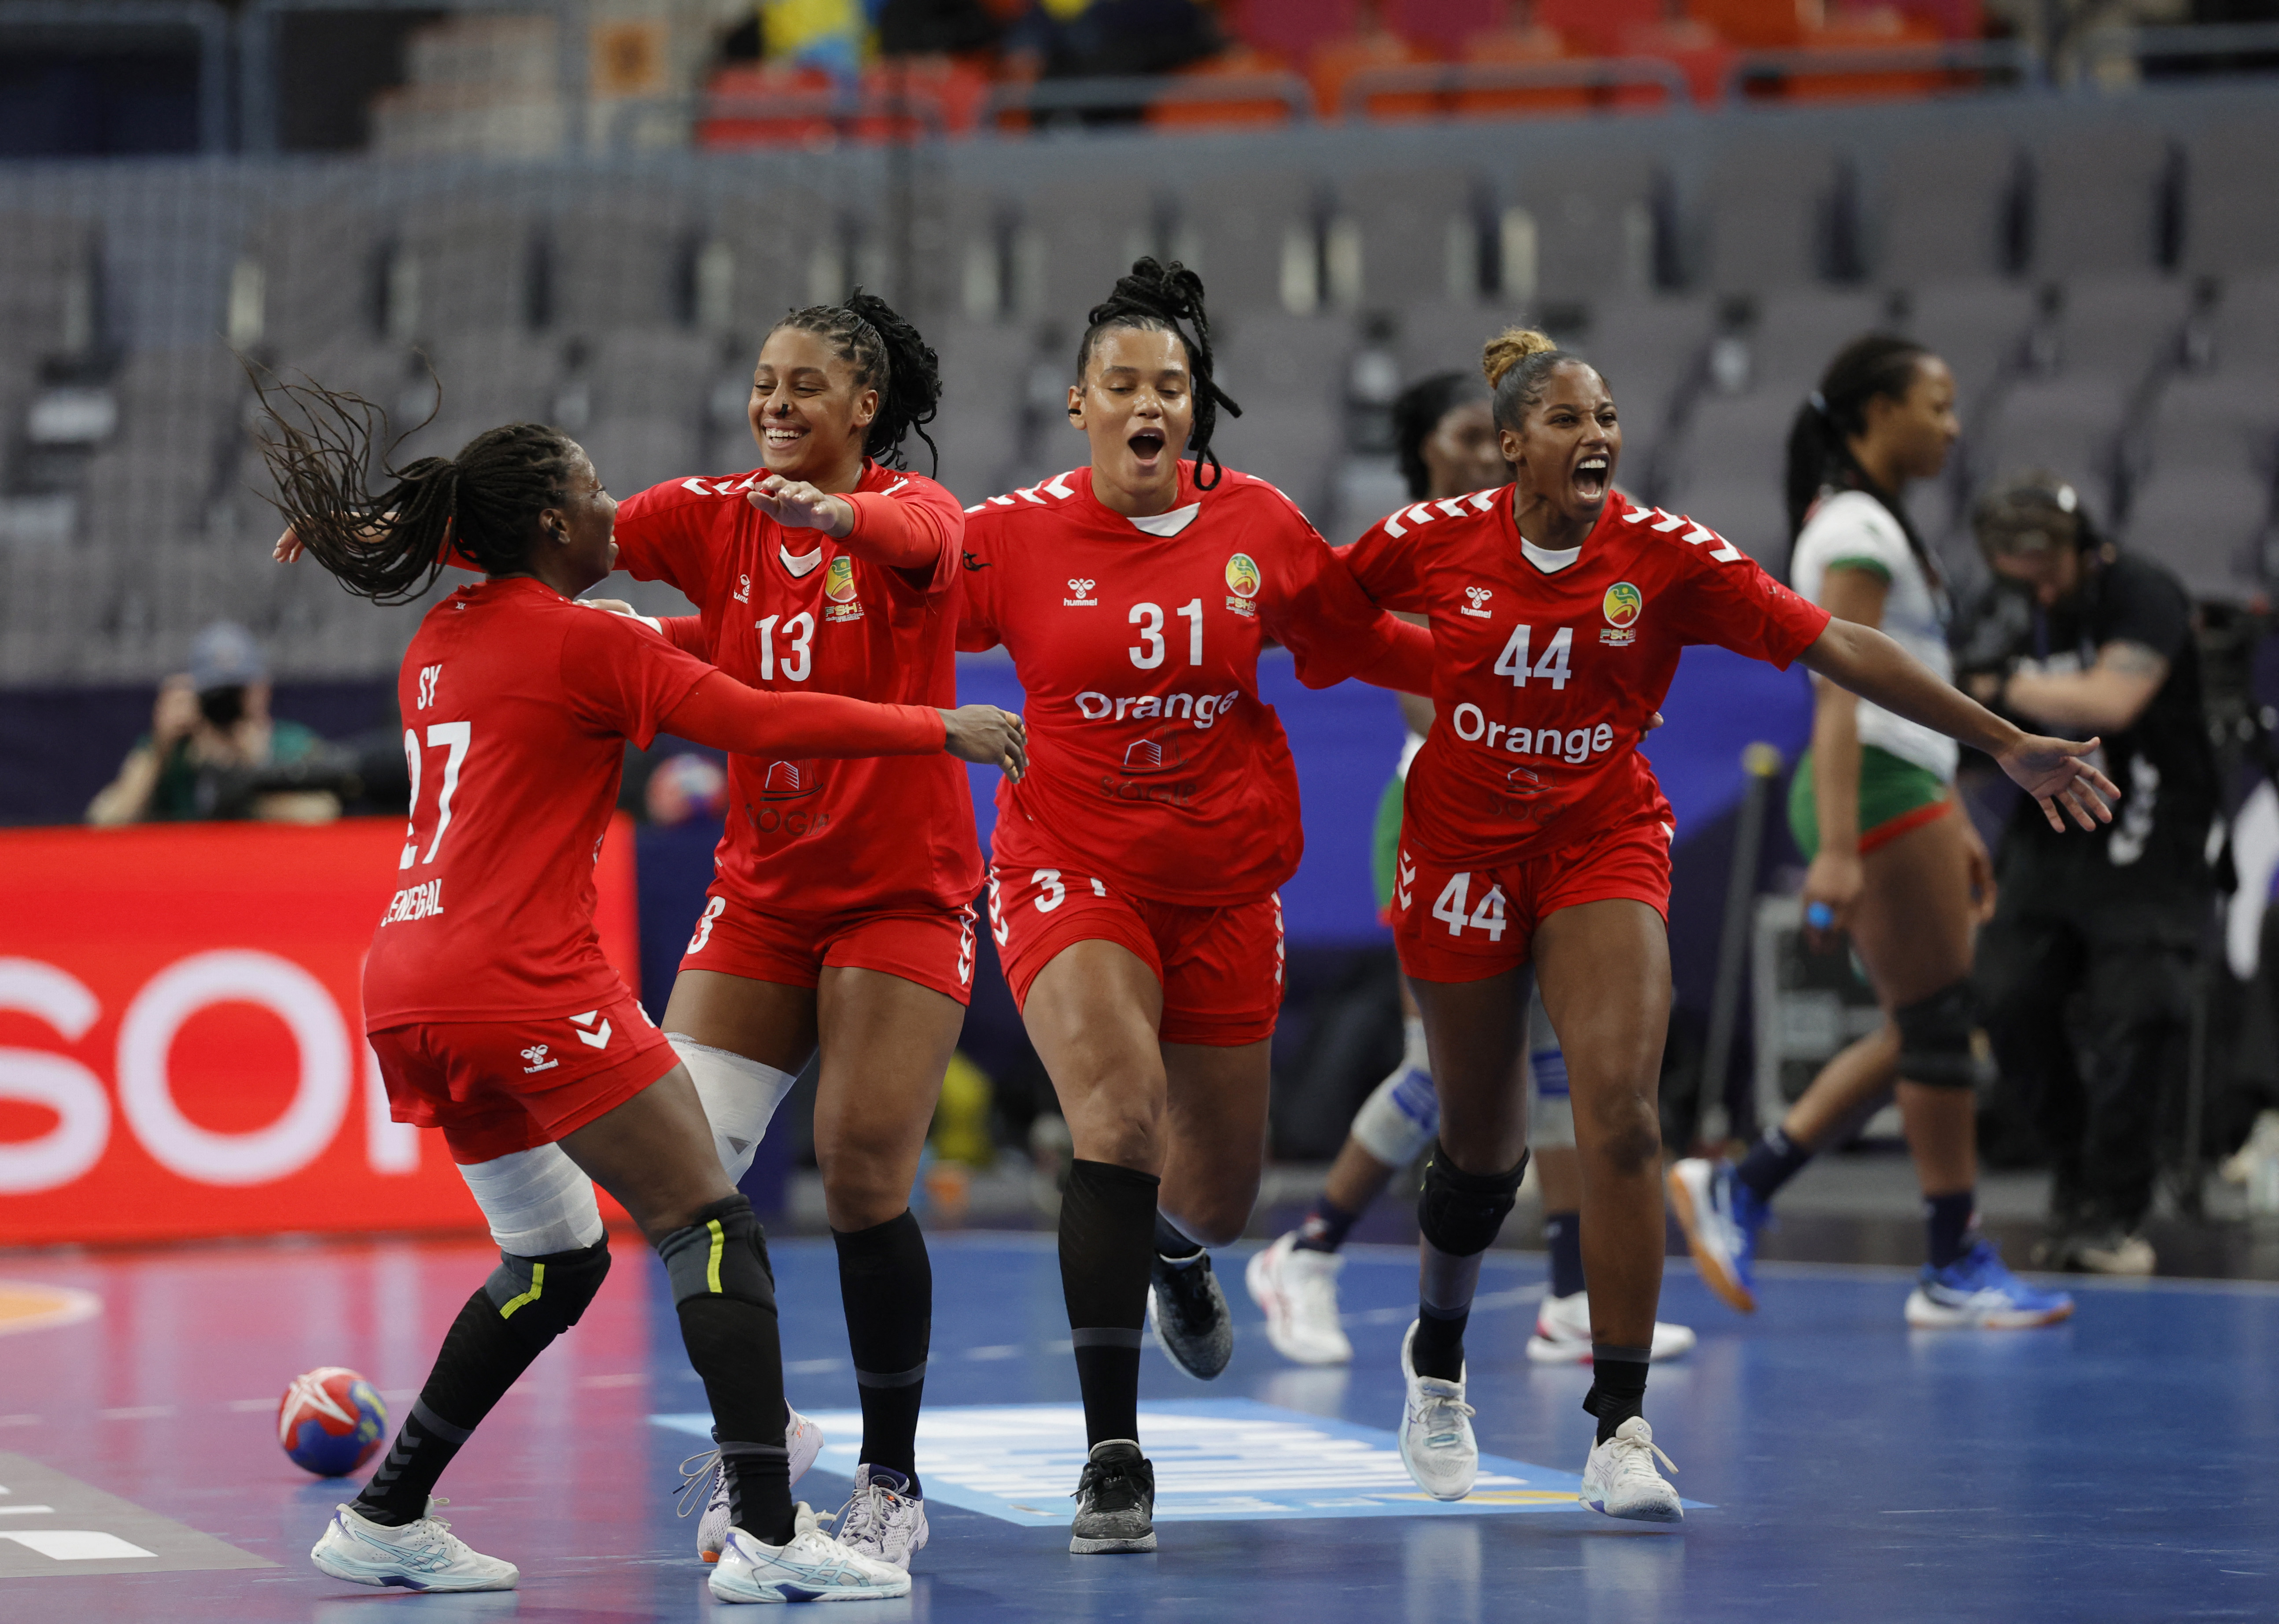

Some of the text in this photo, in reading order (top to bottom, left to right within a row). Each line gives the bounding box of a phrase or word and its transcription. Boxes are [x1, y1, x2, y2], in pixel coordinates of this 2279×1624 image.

[1063, 598, 1097, 606] hummel
[1461, 605, 1492, 619] hummel
[755, 612, 814, 681] 13
[1128, 598, 1203, 669] 31
[1494, 624, 1573, 690] 44
[417, 664, 443, 710] SY
[1075, 690, 1239, 729] Orange
[1453, 702, 1613, 764] Orange
[380, 878, 444, 927] ENEGAL
[1432, 872, 1506, 941] 44
[524, 1058, 559, 1074] hummel
